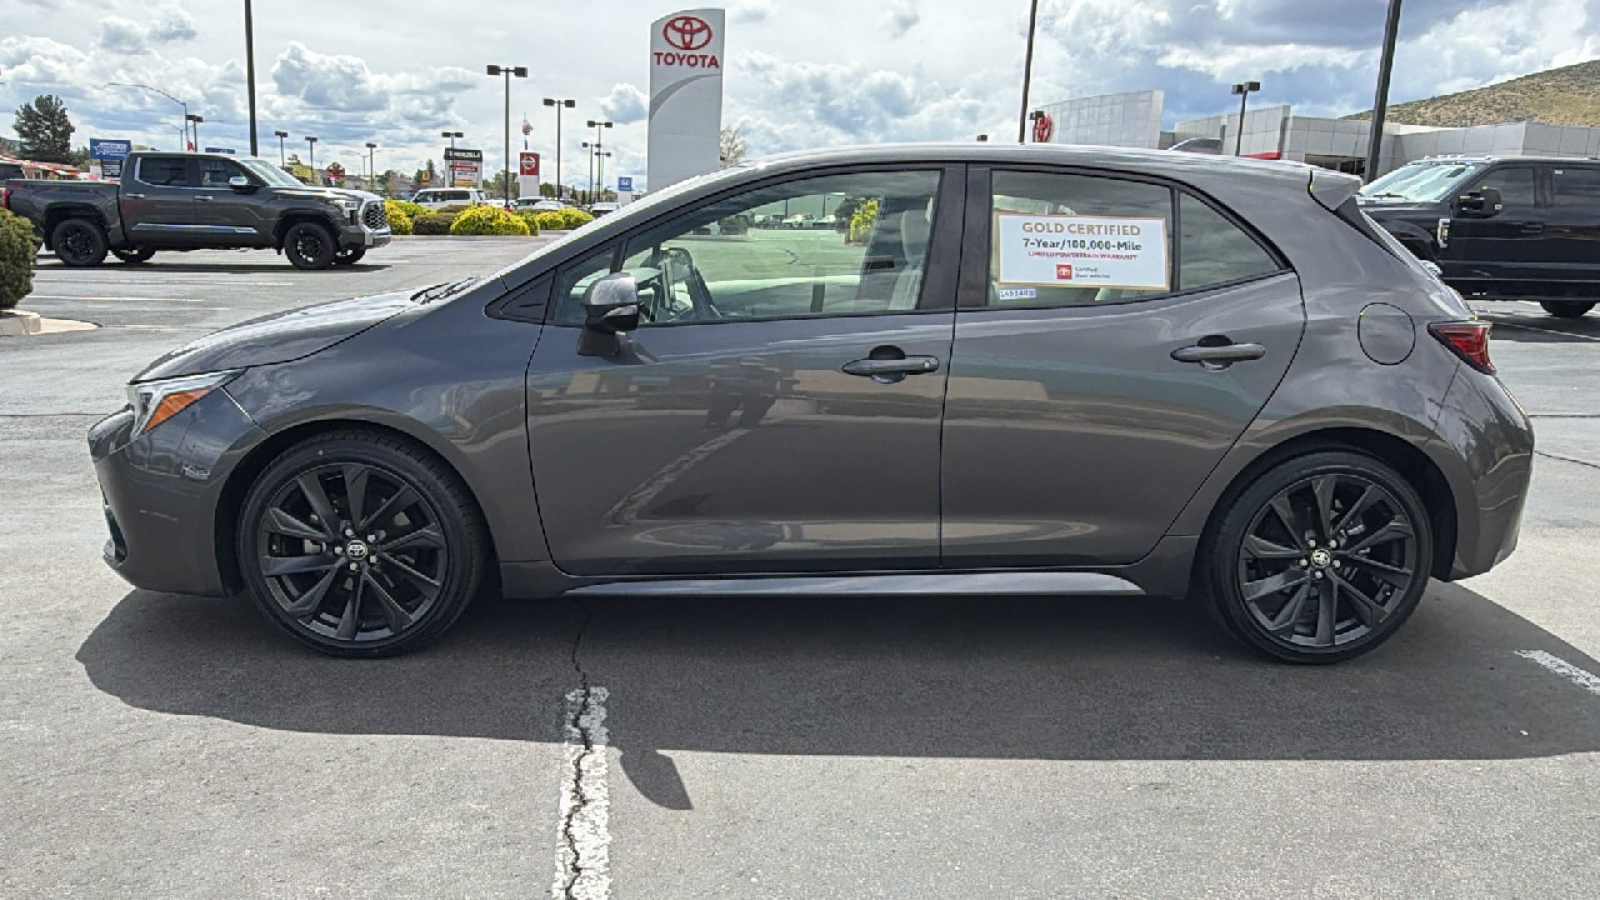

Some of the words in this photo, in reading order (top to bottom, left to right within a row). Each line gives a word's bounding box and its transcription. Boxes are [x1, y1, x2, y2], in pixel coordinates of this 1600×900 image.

[653, 52, 720, 68] TOYOTA
[1022, 222, 1065, 233] GOLD
[1067, 223, 1141, 236] CERTIFIED
[1022, 238, 1142, 251] 7-Year/100,000-Mile
